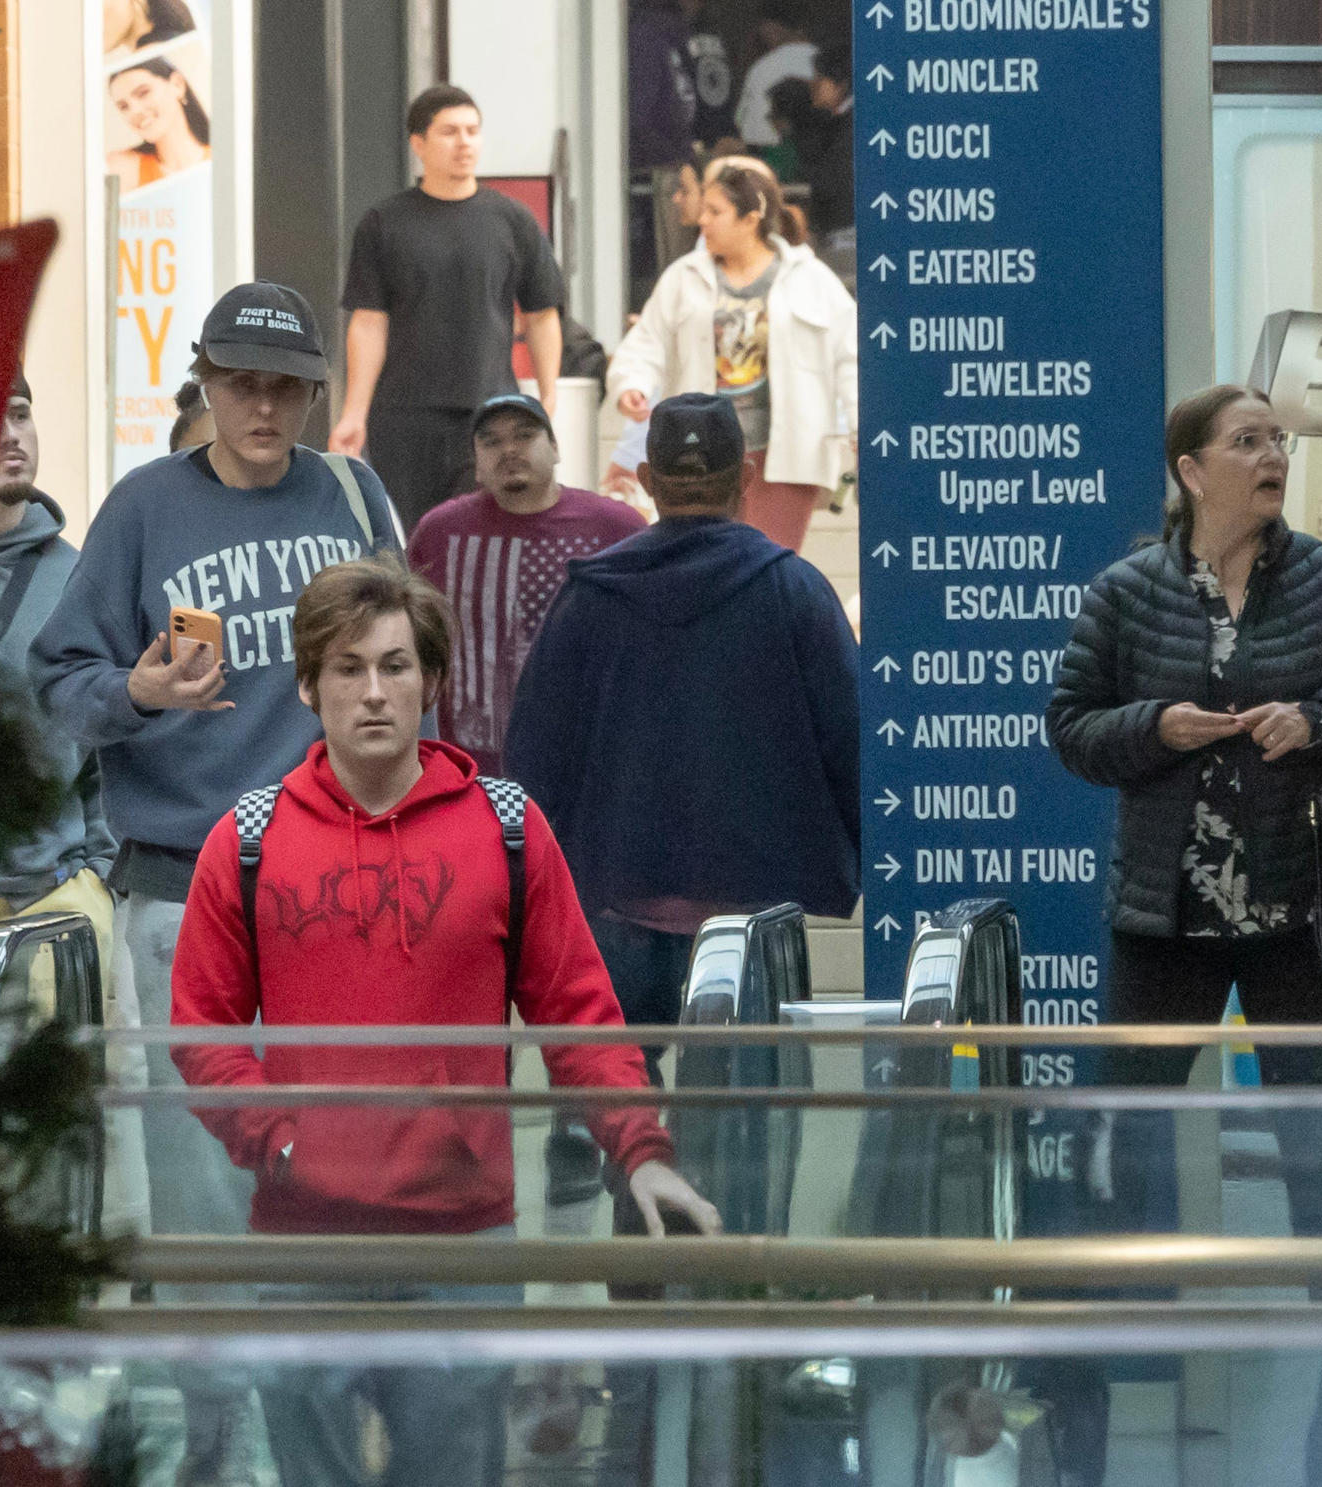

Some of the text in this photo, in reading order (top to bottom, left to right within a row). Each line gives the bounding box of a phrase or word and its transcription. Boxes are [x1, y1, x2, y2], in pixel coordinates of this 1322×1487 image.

[906, 59, 1039, 93] MONCLER
[906, 124, 990, 159] GUCCI
[907, 189, 995, 222] SKIMS
[908, 249, 1036, 284] EATERIES
[235, 316, 264, 326] READ
[239, 308, 274, 318] FIGHT
[909, 317, 1004, 352] BHINDI
[944, 362, 1091, 397] JEWELERS
[910, 424, 1080, 459] RESTROOMS
[940, 469, 1106, 513] Upper Level
[162, 541, 261, 612] NEW
[945, 584, 1089, 620] ESCALATO
[913, 650, 1065, 685] GOLD'S GY
[914, 785, 1016, 820] UNIQLO
[916, 848, 1096, 883] DIN TAI FUNG
[1021, 955, 1099, 989] RTING
